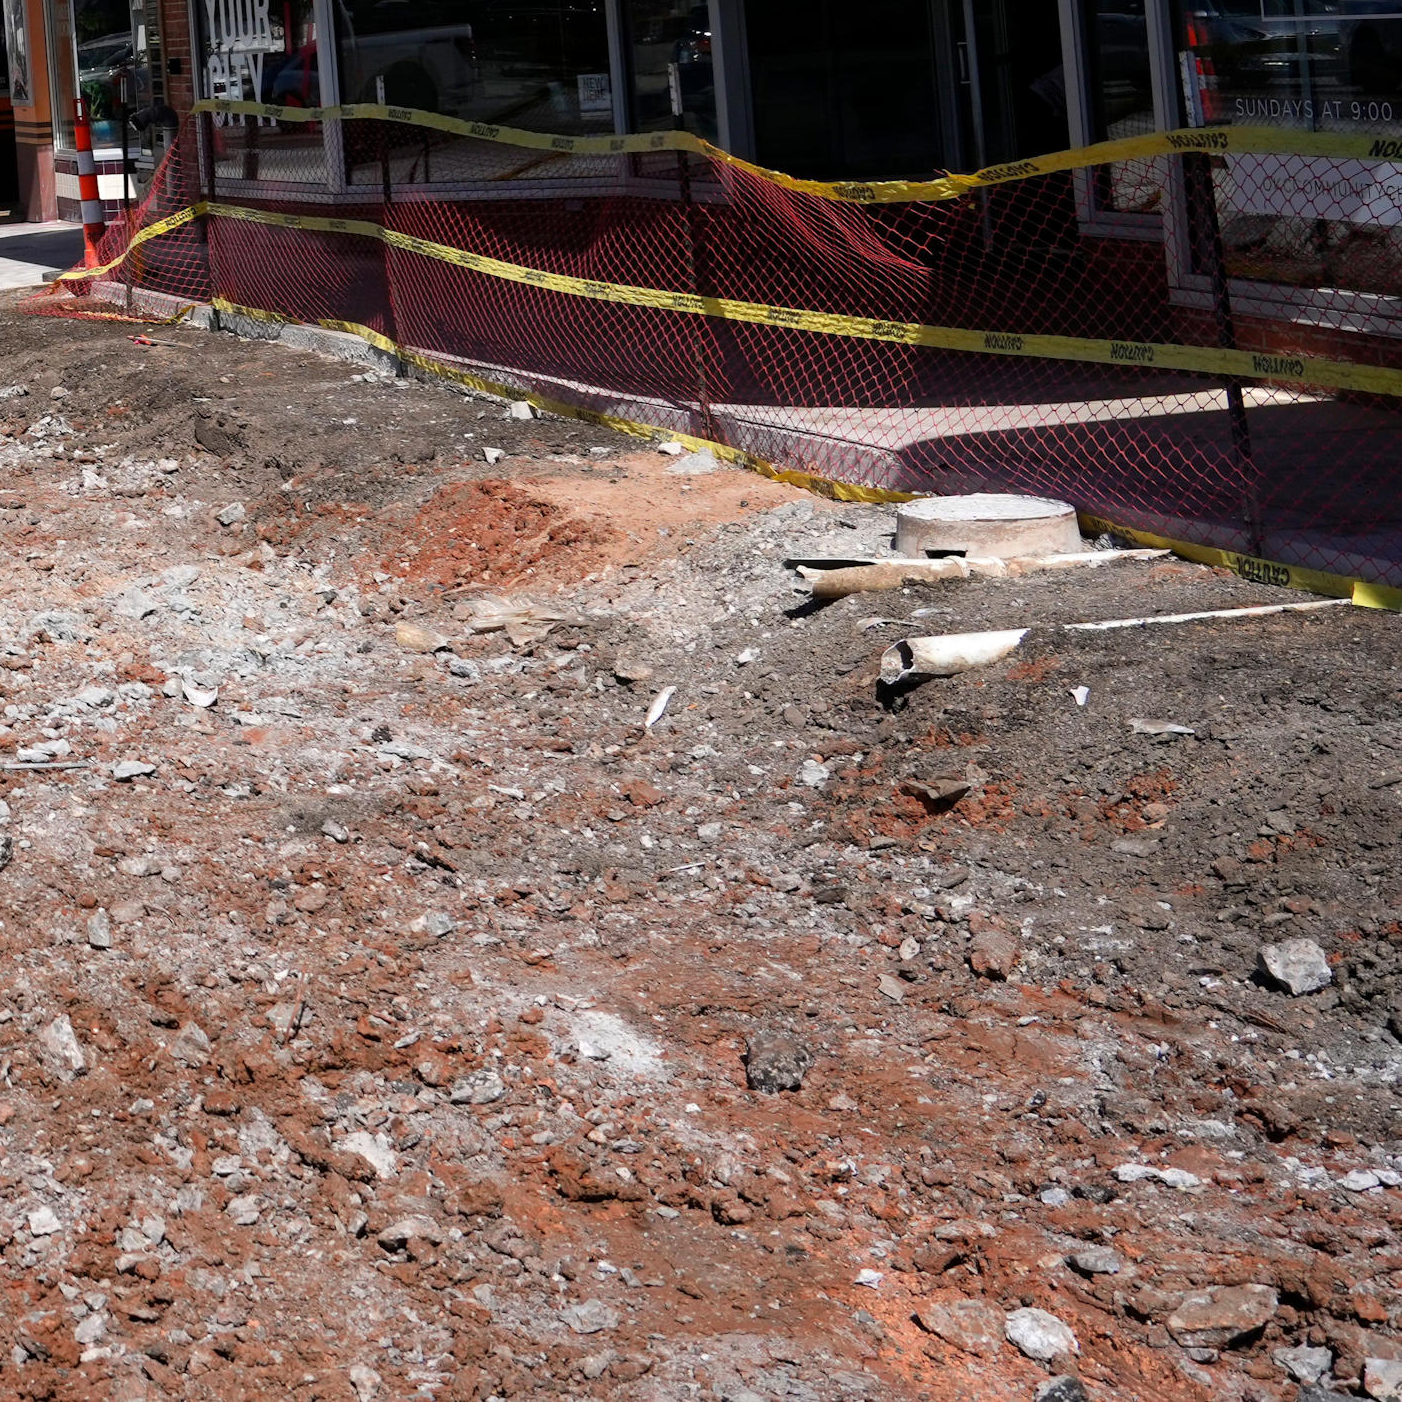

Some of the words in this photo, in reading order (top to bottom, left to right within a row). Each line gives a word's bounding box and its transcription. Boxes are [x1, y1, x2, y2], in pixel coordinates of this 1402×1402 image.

[206, 53, 277, 127] CITY
[1235, 98, 1314, 119] SUNDAYS
[1321, 100, 1342, 119] AT
[1351, 101, 1393, 122] 9:00
[1165, 132, 1228, 149] CAUTION
[165, 207, 197, 227] CAUTION
[983, 332, 1026, 350] CAUTION
[1110, 341, 1154, 362] CAUTION
[1252, 354, 1305, 376] CAUTION
[1236, 556, 1290, 586] CAUTION
